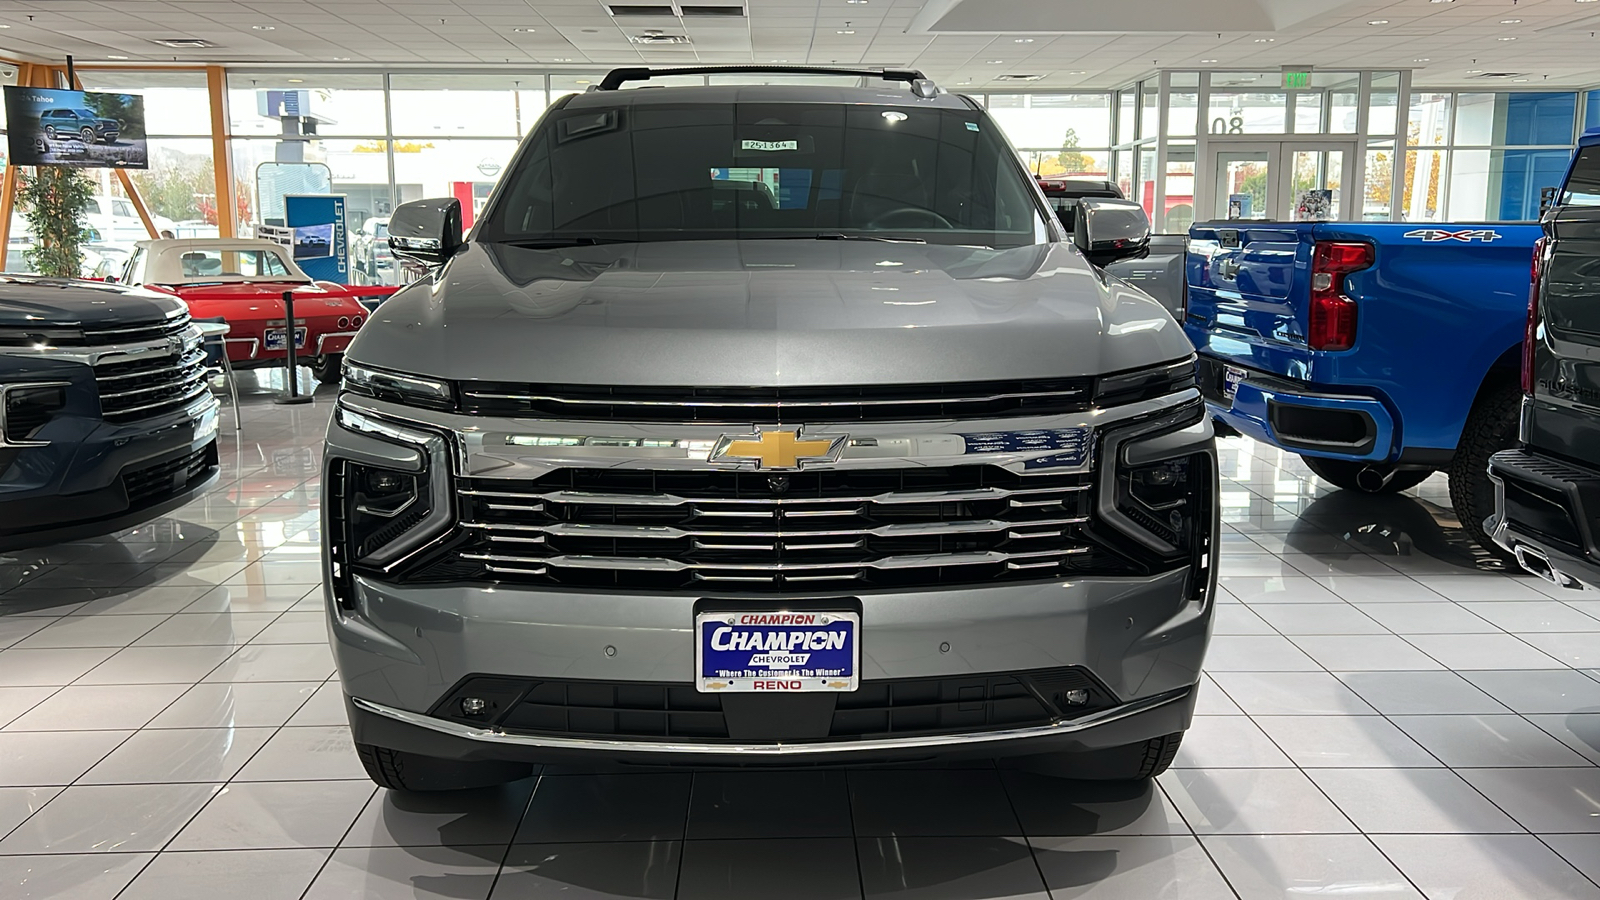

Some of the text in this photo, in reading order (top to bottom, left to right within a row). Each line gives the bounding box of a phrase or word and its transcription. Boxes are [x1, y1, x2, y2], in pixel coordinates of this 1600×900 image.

[1287, 72, 1308, 88] EXIT
[32, 95, 54, 103] Tahoe
[334, 200, 346, 273] CHEVROLET
[741, 614, 815, 625] CHAMPION
[710, 626, 847, 652] CHAMPION
[753, 655, 806, 664] CHEVROLET
[744, 669, 756, 677] The
[758, 669, 792, 677] Customer
[801, 669, 814, 677] The
[753, 680, 802, 690] RENO
